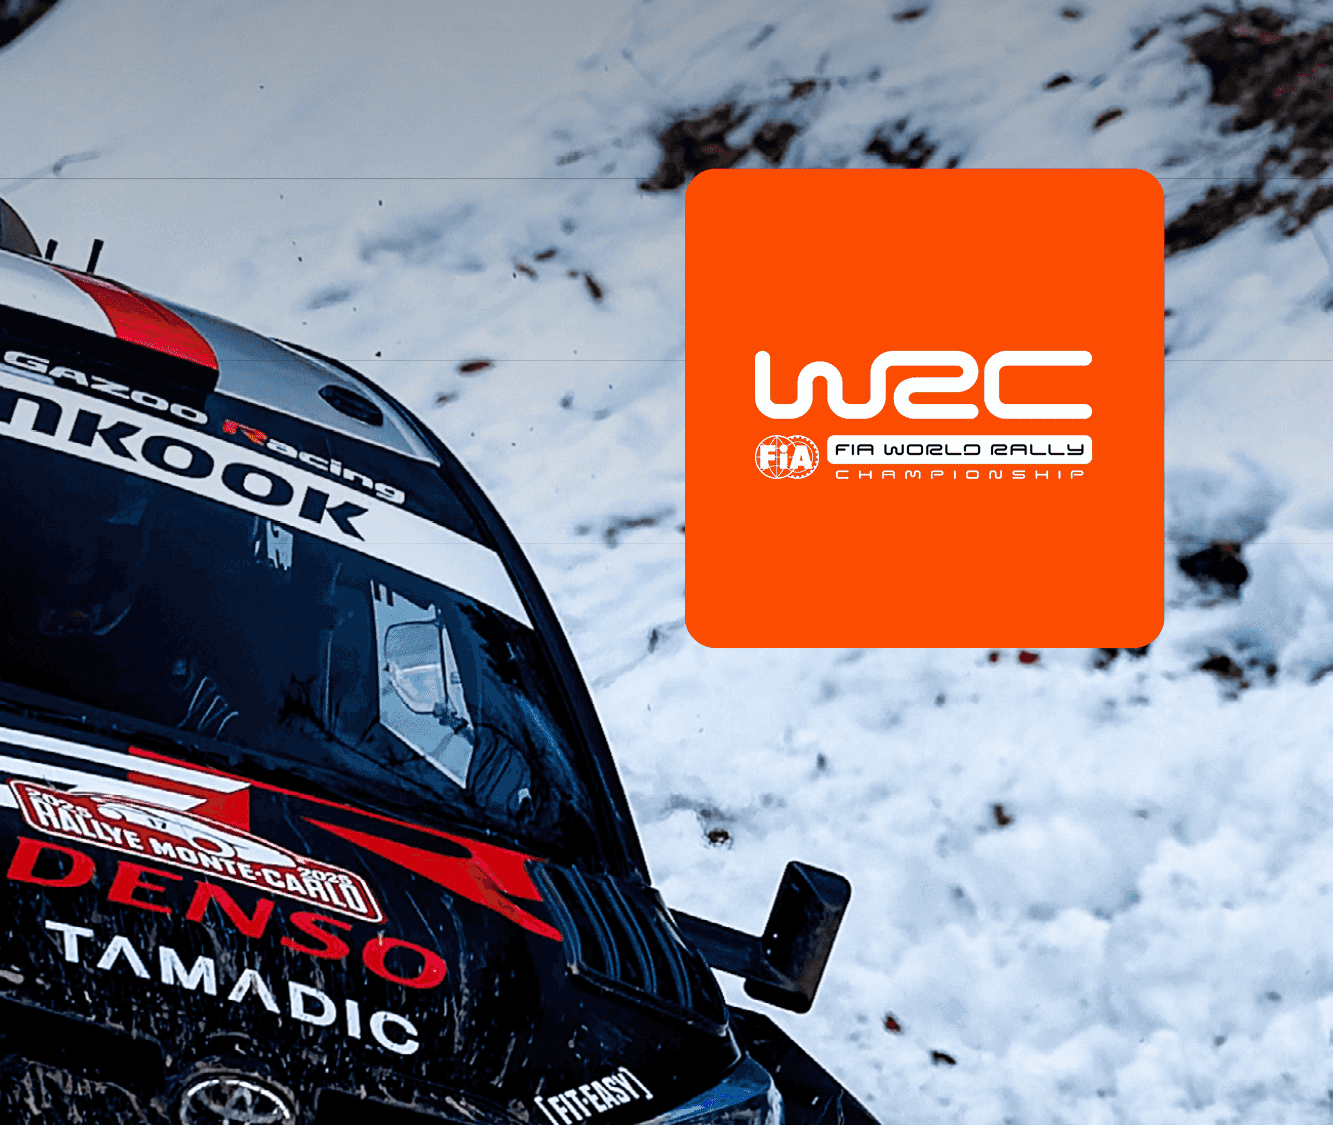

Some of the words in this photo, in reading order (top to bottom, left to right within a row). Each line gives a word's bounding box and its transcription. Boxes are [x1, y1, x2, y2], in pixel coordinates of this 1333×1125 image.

[4, 351, 208, 425] GAZOO
[223, 419, 406, 505] Racing
[29, 795, 144, 850] RALLYE
[6, 836, 447, 989] DENSO
[45, 919, 419, 1055] TAMADIC
